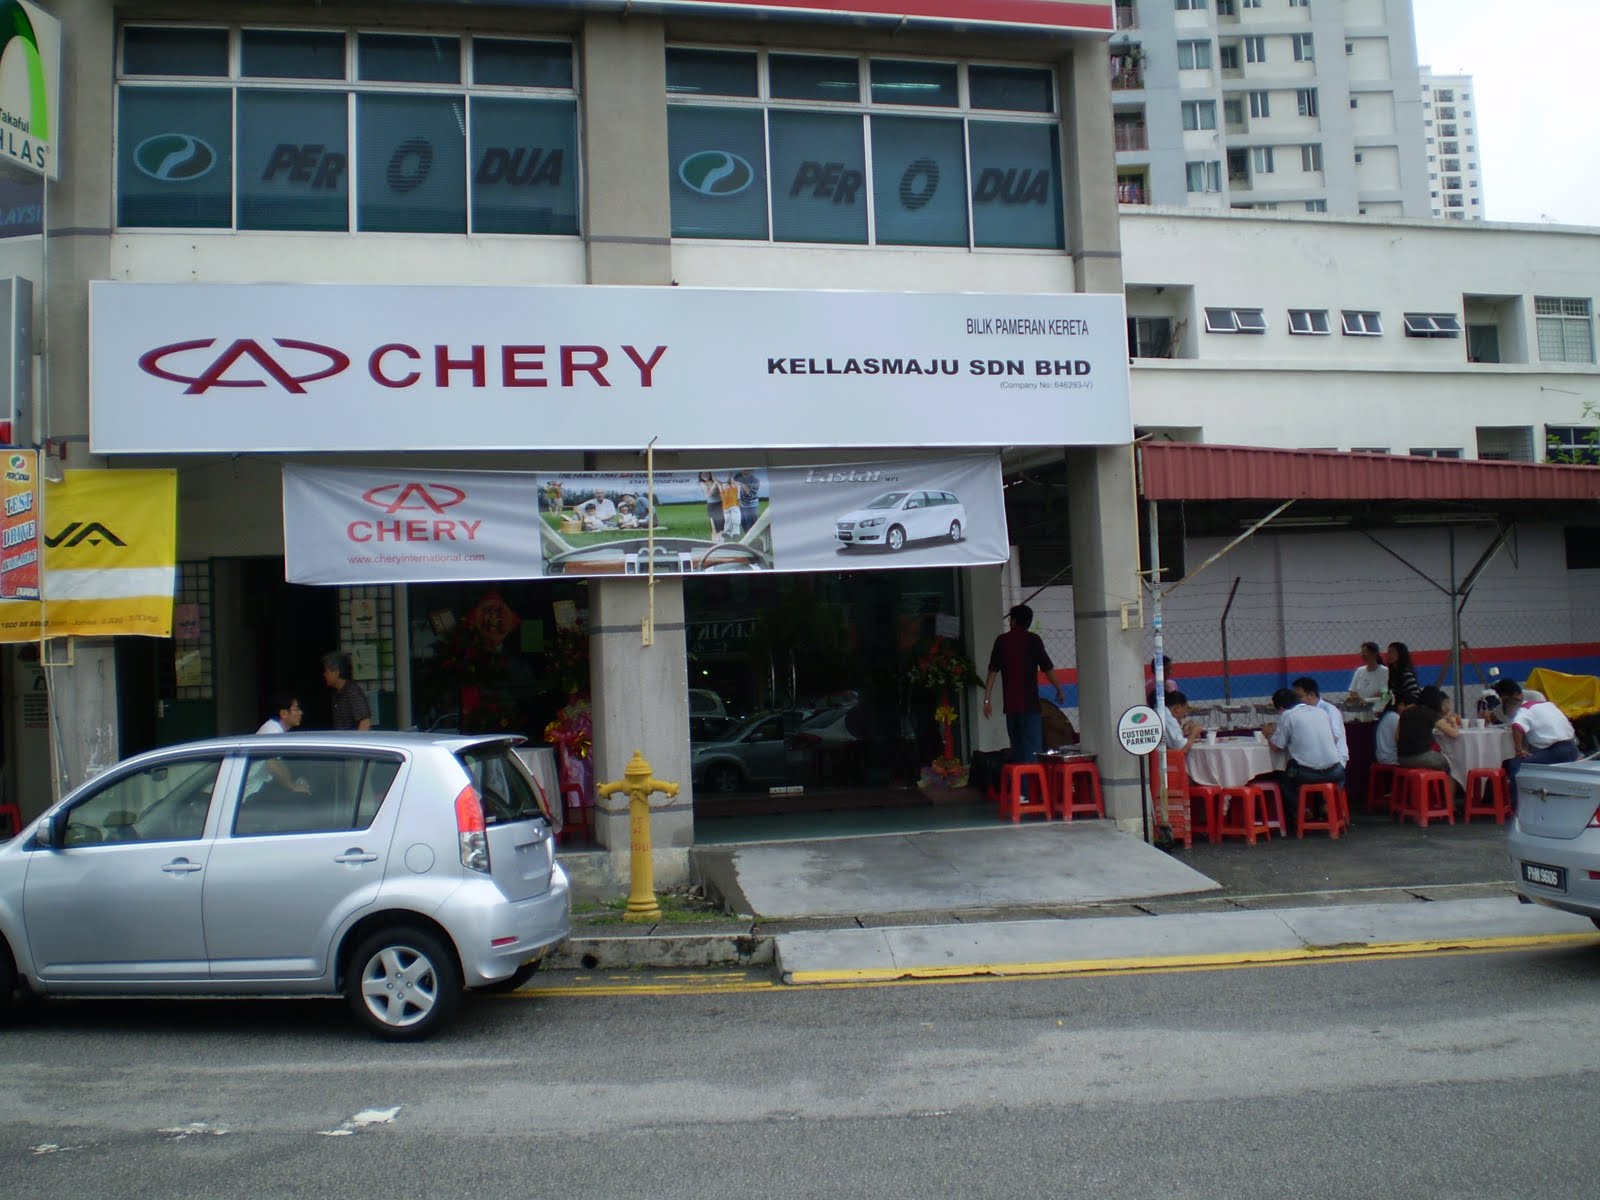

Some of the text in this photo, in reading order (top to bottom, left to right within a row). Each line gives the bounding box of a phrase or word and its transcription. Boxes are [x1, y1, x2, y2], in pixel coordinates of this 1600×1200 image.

[262, 144, 346, 190] PER
[475, 147, 565, 186] DUA
[790, 161, 863, 205] PER
[974, 167, 1049, 204] DUA
[966, 318, 1090, 335] BILIK PAMERAN KERETA
[368, 343, 668, 388] CHERY
[767, 358, 1091, 376] KELLASMAJU SDN BHD
[1000, 381, 1038, 389] (Company
[5, 491, 33, 516] TEST
[3, 520, 35, 548] DRIVE
[346, 520, 482, 543] CHERY
[347, 553, 485, 564] www.cheryinternational.com
[1122, 728, 1159, 739] CUSTOMER
[1126, 736, 1156, 746] PARKING
